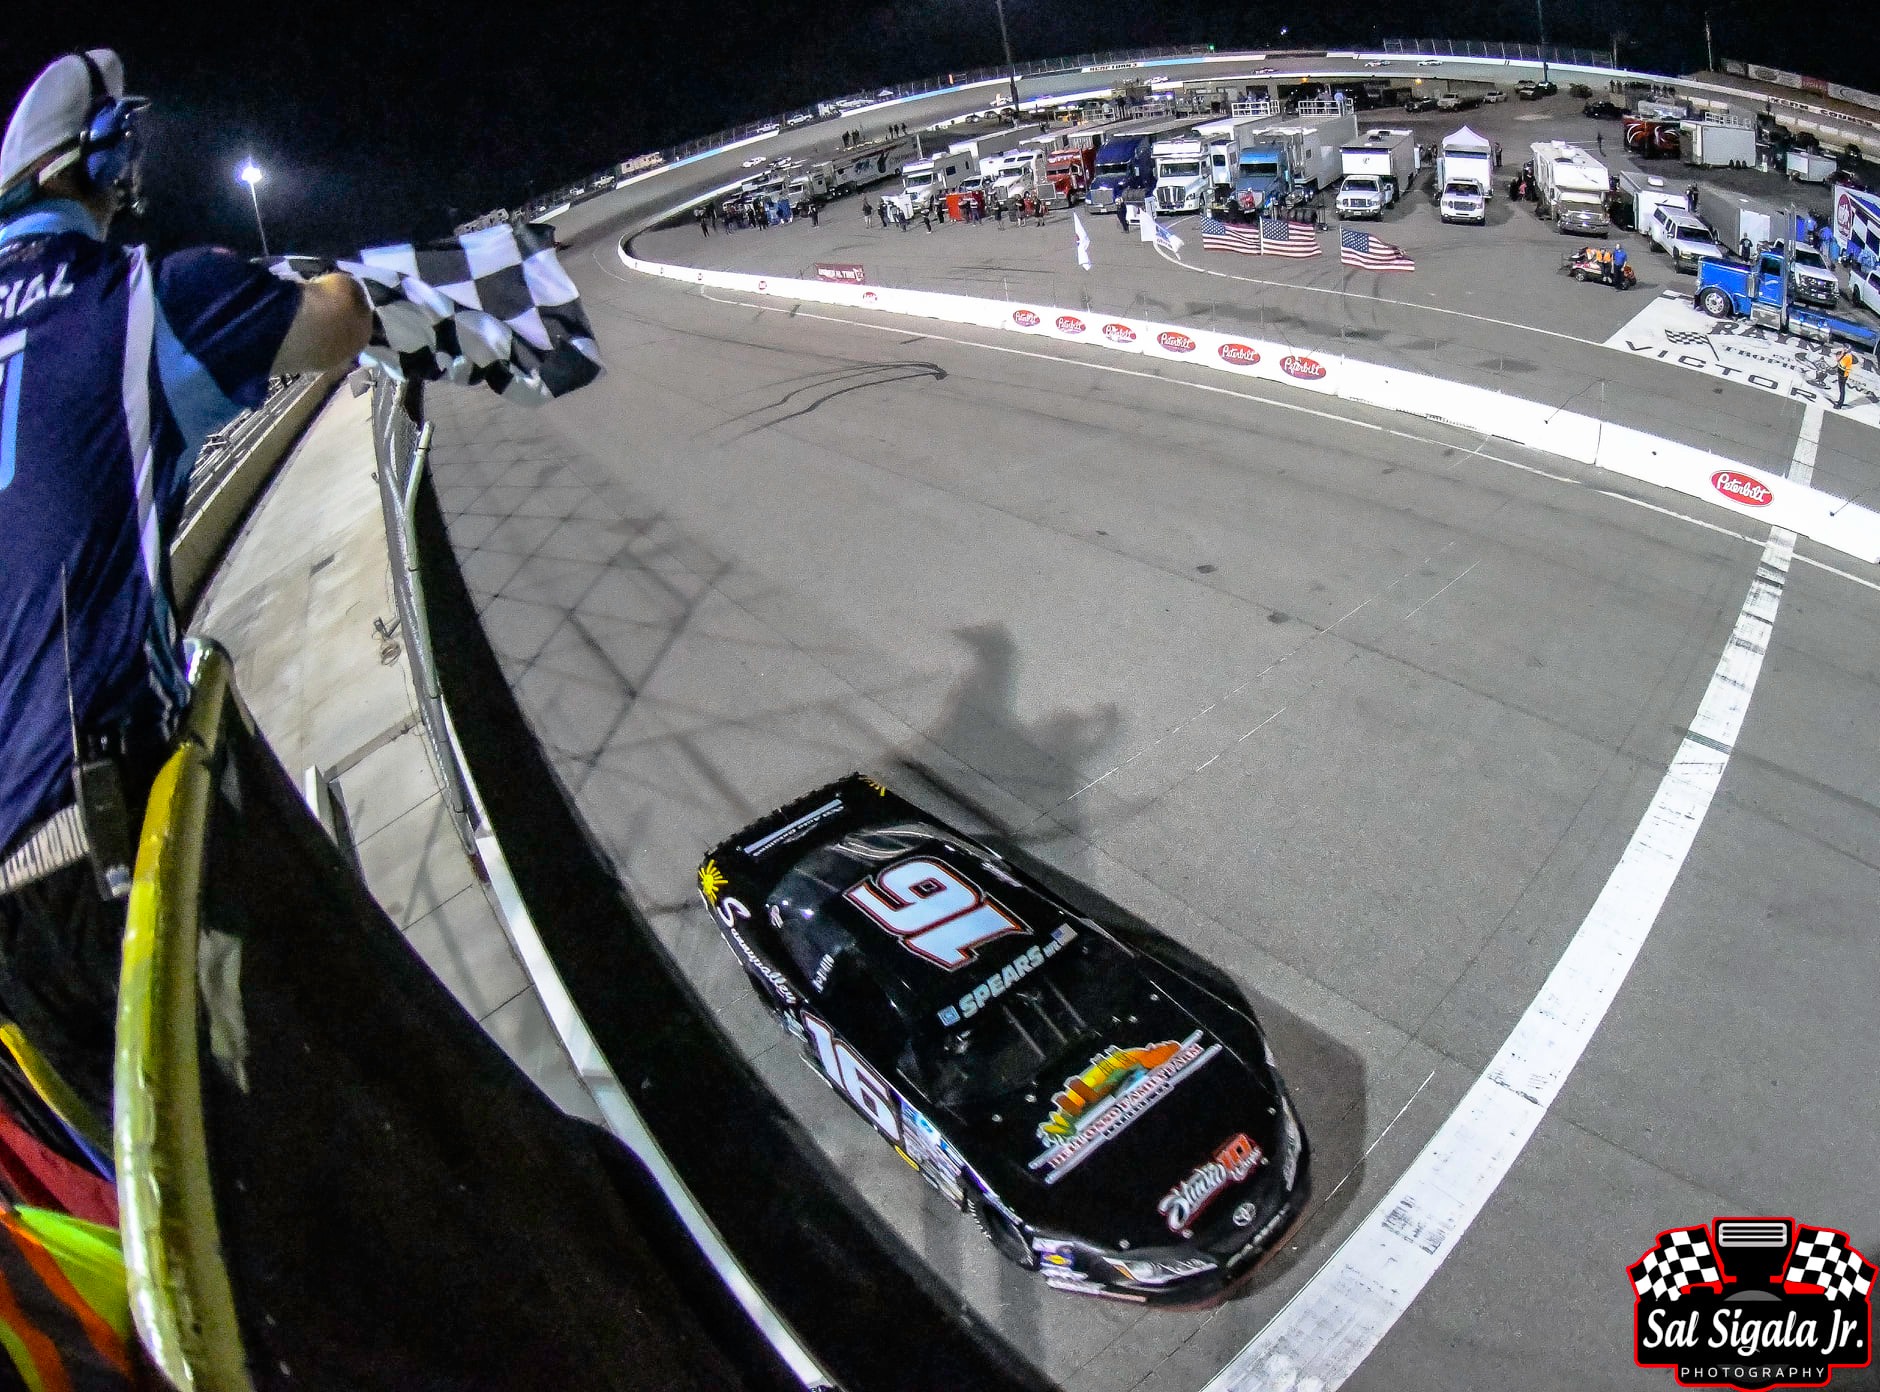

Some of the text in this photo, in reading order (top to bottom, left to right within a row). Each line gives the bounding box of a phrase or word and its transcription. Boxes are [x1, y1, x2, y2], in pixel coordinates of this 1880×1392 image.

[1161, 332, 1192, 349] Peterbilt
[1222, 344, 1257, 362] Peterbilt
[1716, 474, 1768, 502] Peterbilt
[958, 944, 1046, 1019] SPEARS
[801, 1009, 903, 1146] 16
